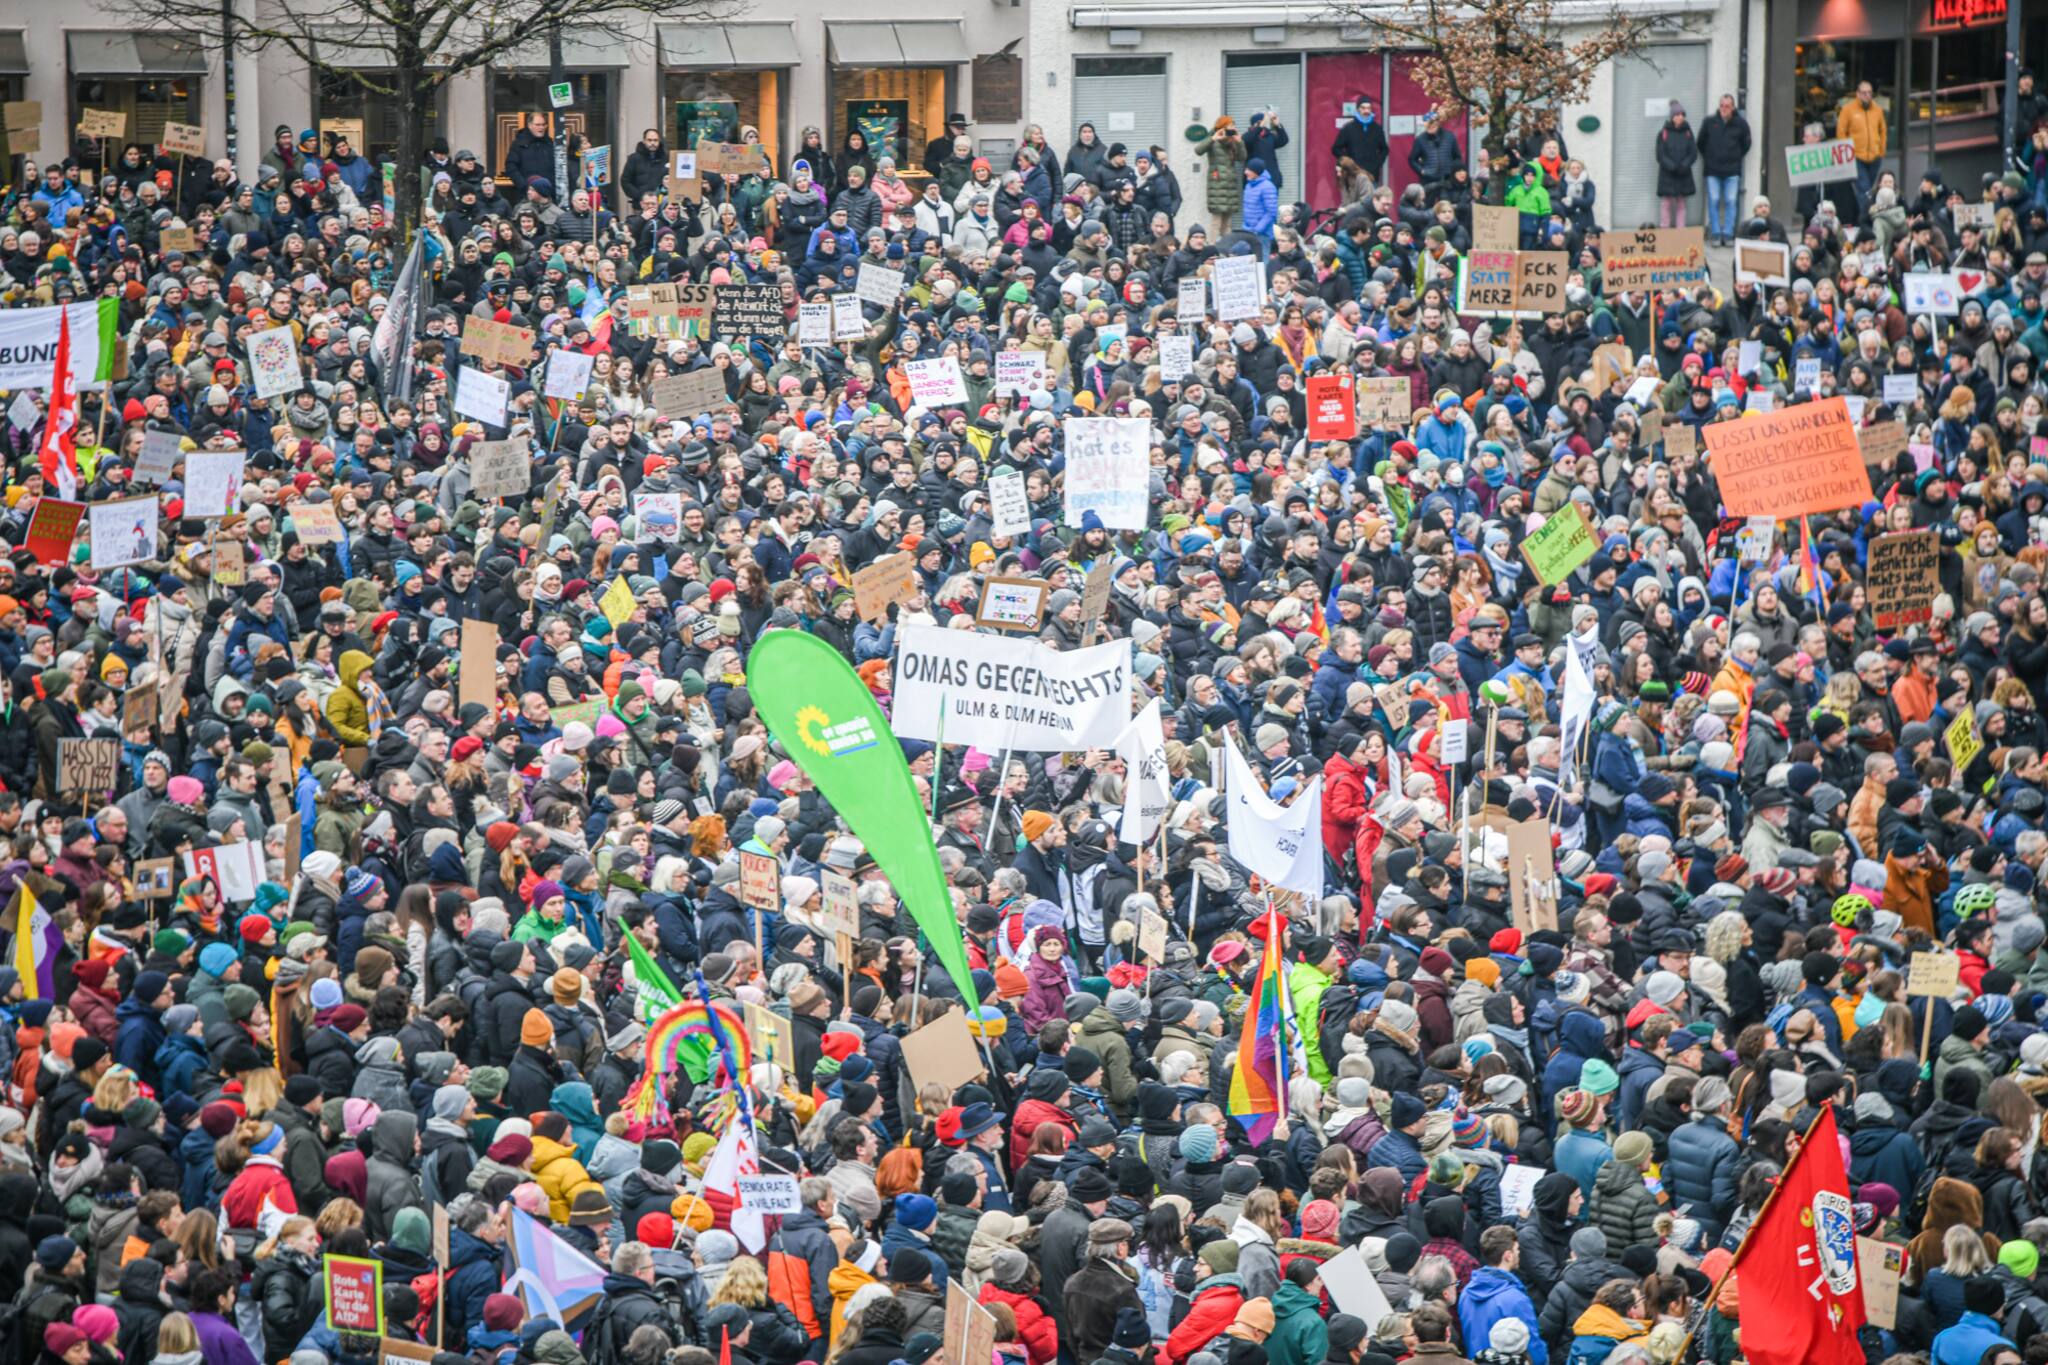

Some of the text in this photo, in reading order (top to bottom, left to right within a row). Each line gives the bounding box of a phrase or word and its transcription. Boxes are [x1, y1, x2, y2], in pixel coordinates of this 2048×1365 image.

[1635, 233, 1656, 244] WO
[1472, 253, 1514, 267] HERZ
[1524, 262, 1558, 277] FCK
[1470, 271, 1511, 286] STATT
[1608, 275, 1624, 287] WO
[717, 286, 781, 299] Wenn die AfD
[1468, 289, 1512, 305] MERZ
[1521, 283, 1557, 299] AFD
[733, 298, 769, 312] Antwort
[733, 311, 760, 323] dumm
[761, 313, 784, 324] war
[998, 353, 1020, 361] NACH
[999, 360, 1036, 369] SCHWARZ
[907, 362, 927, 372] DAS
[1316, 392, 1344, 401] KARTE
[1711, 409, 1847, 450] LASST UNS HANDELN
[1071, 438, 1134, 459] hat es
[1782, 461, 1830, 485] BLEIBT
[1830, 455, 1851, 473] SIE
[1731, 498, 1765, 516] KEIN
[1873, 535, 1933, 557] wer nicht
[1871, 554, 1909, 573] denkt
[1918, 554, 1939, 569] wer
[1868, 572, 1902, 587] nichts
[1877, 586, 1897, 600] der
[903, 652, 1123, 707] OMAS GEGEN ECHTS
[956, 699, 987, 717] ULM
[991, 705, 1001, 720] &
[62, 740, 114, 766] HASS IST
[69, 765, 114, 790] SO 1933
[754, 1198, 792, 1210] VIELFALT
[333, 1273, 359, 1288] Rote
[334, 1286, 365, 1300] Karte
[335, 1297, 369, 1313] für die
